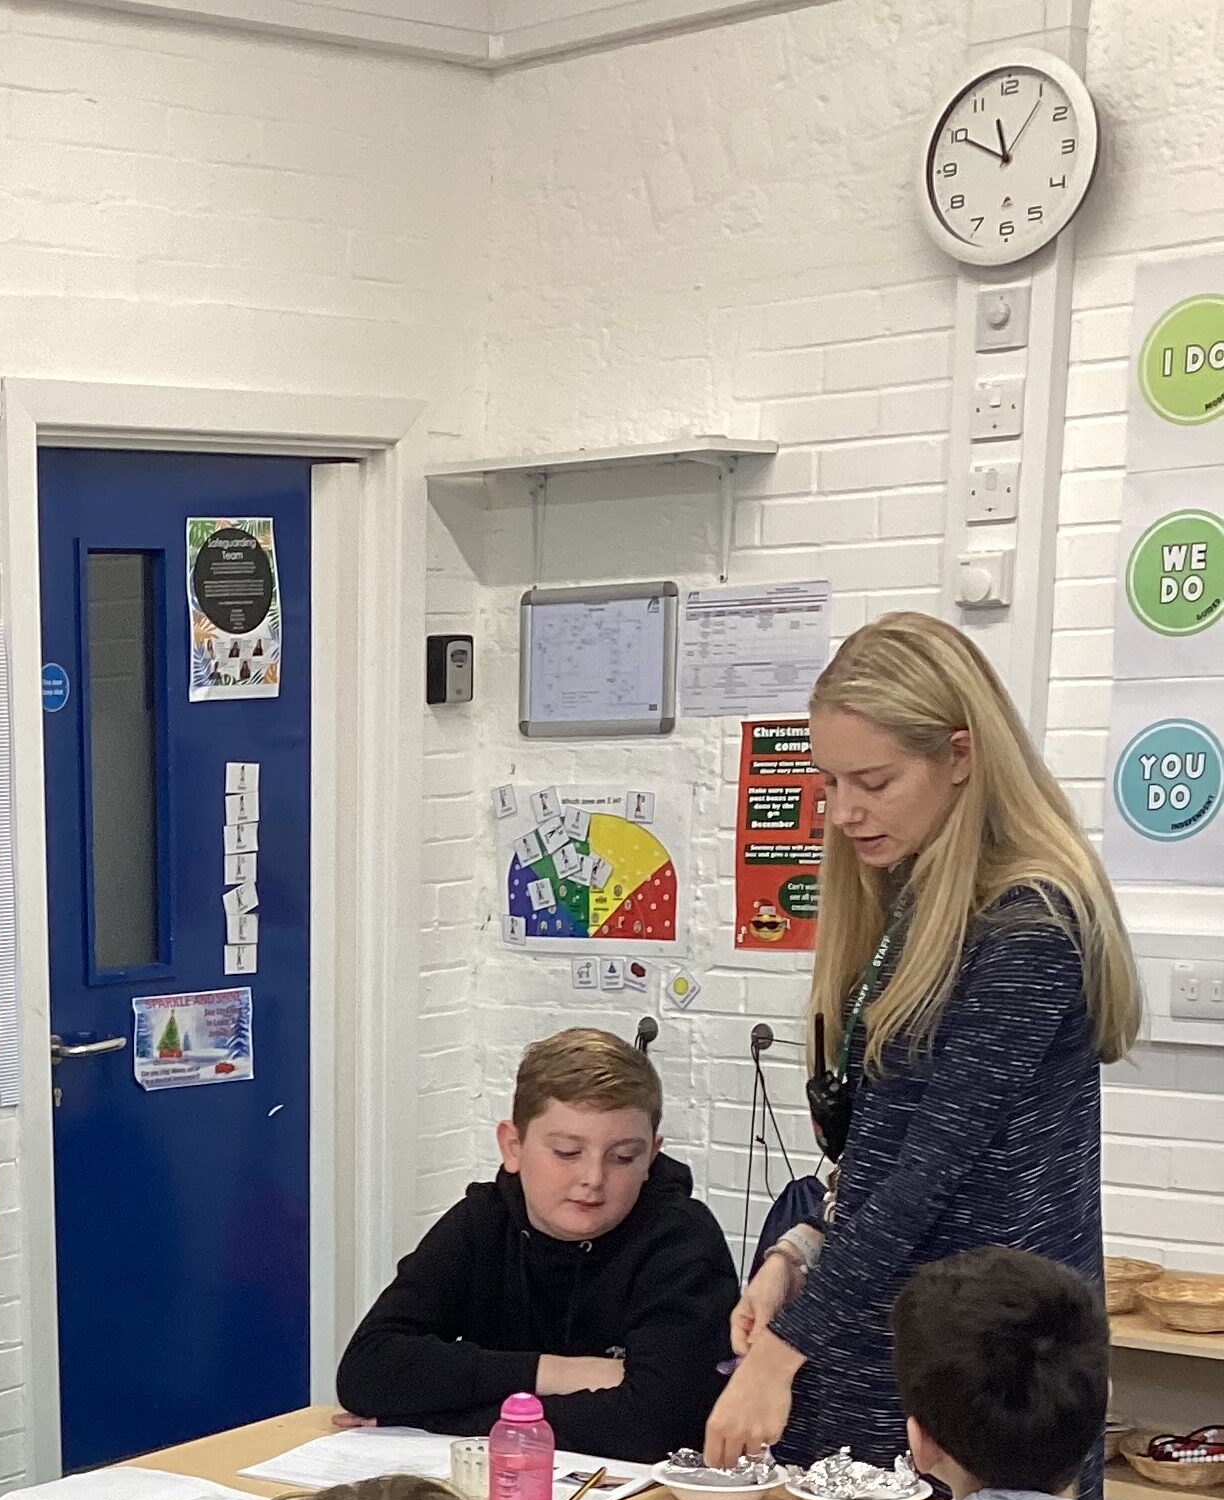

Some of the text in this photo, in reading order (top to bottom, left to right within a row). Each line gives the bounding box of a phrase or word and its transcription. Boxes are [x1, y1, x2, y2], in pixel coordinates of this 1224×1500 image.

[1001, 79, 1019, 96] 12
[974, 98, 985, 113] 11
[1053, 105, 1068, 122] 2
[951, 128, 968, 144] 10
[1061, 138, 1075, 155] 3
[943, 162, 957, 178] 9
[1050, 175, 1066, 189] 4
[950, 194, 965, 209] 8
[1028, 206, 1043, 222] 5
[971, 217, 984, 231] 7
[999, 221, 1014, 236] 6
[1162, 340, 1224, 377] I DO
[1162, 542, 1207, 573] WE
[1160, 574, 1204, 604] DO
[1139, 752, 1206, 780] YOU
[1147, 783, 1191, 810] DO
[872, 935, 891, 967] STAFF
